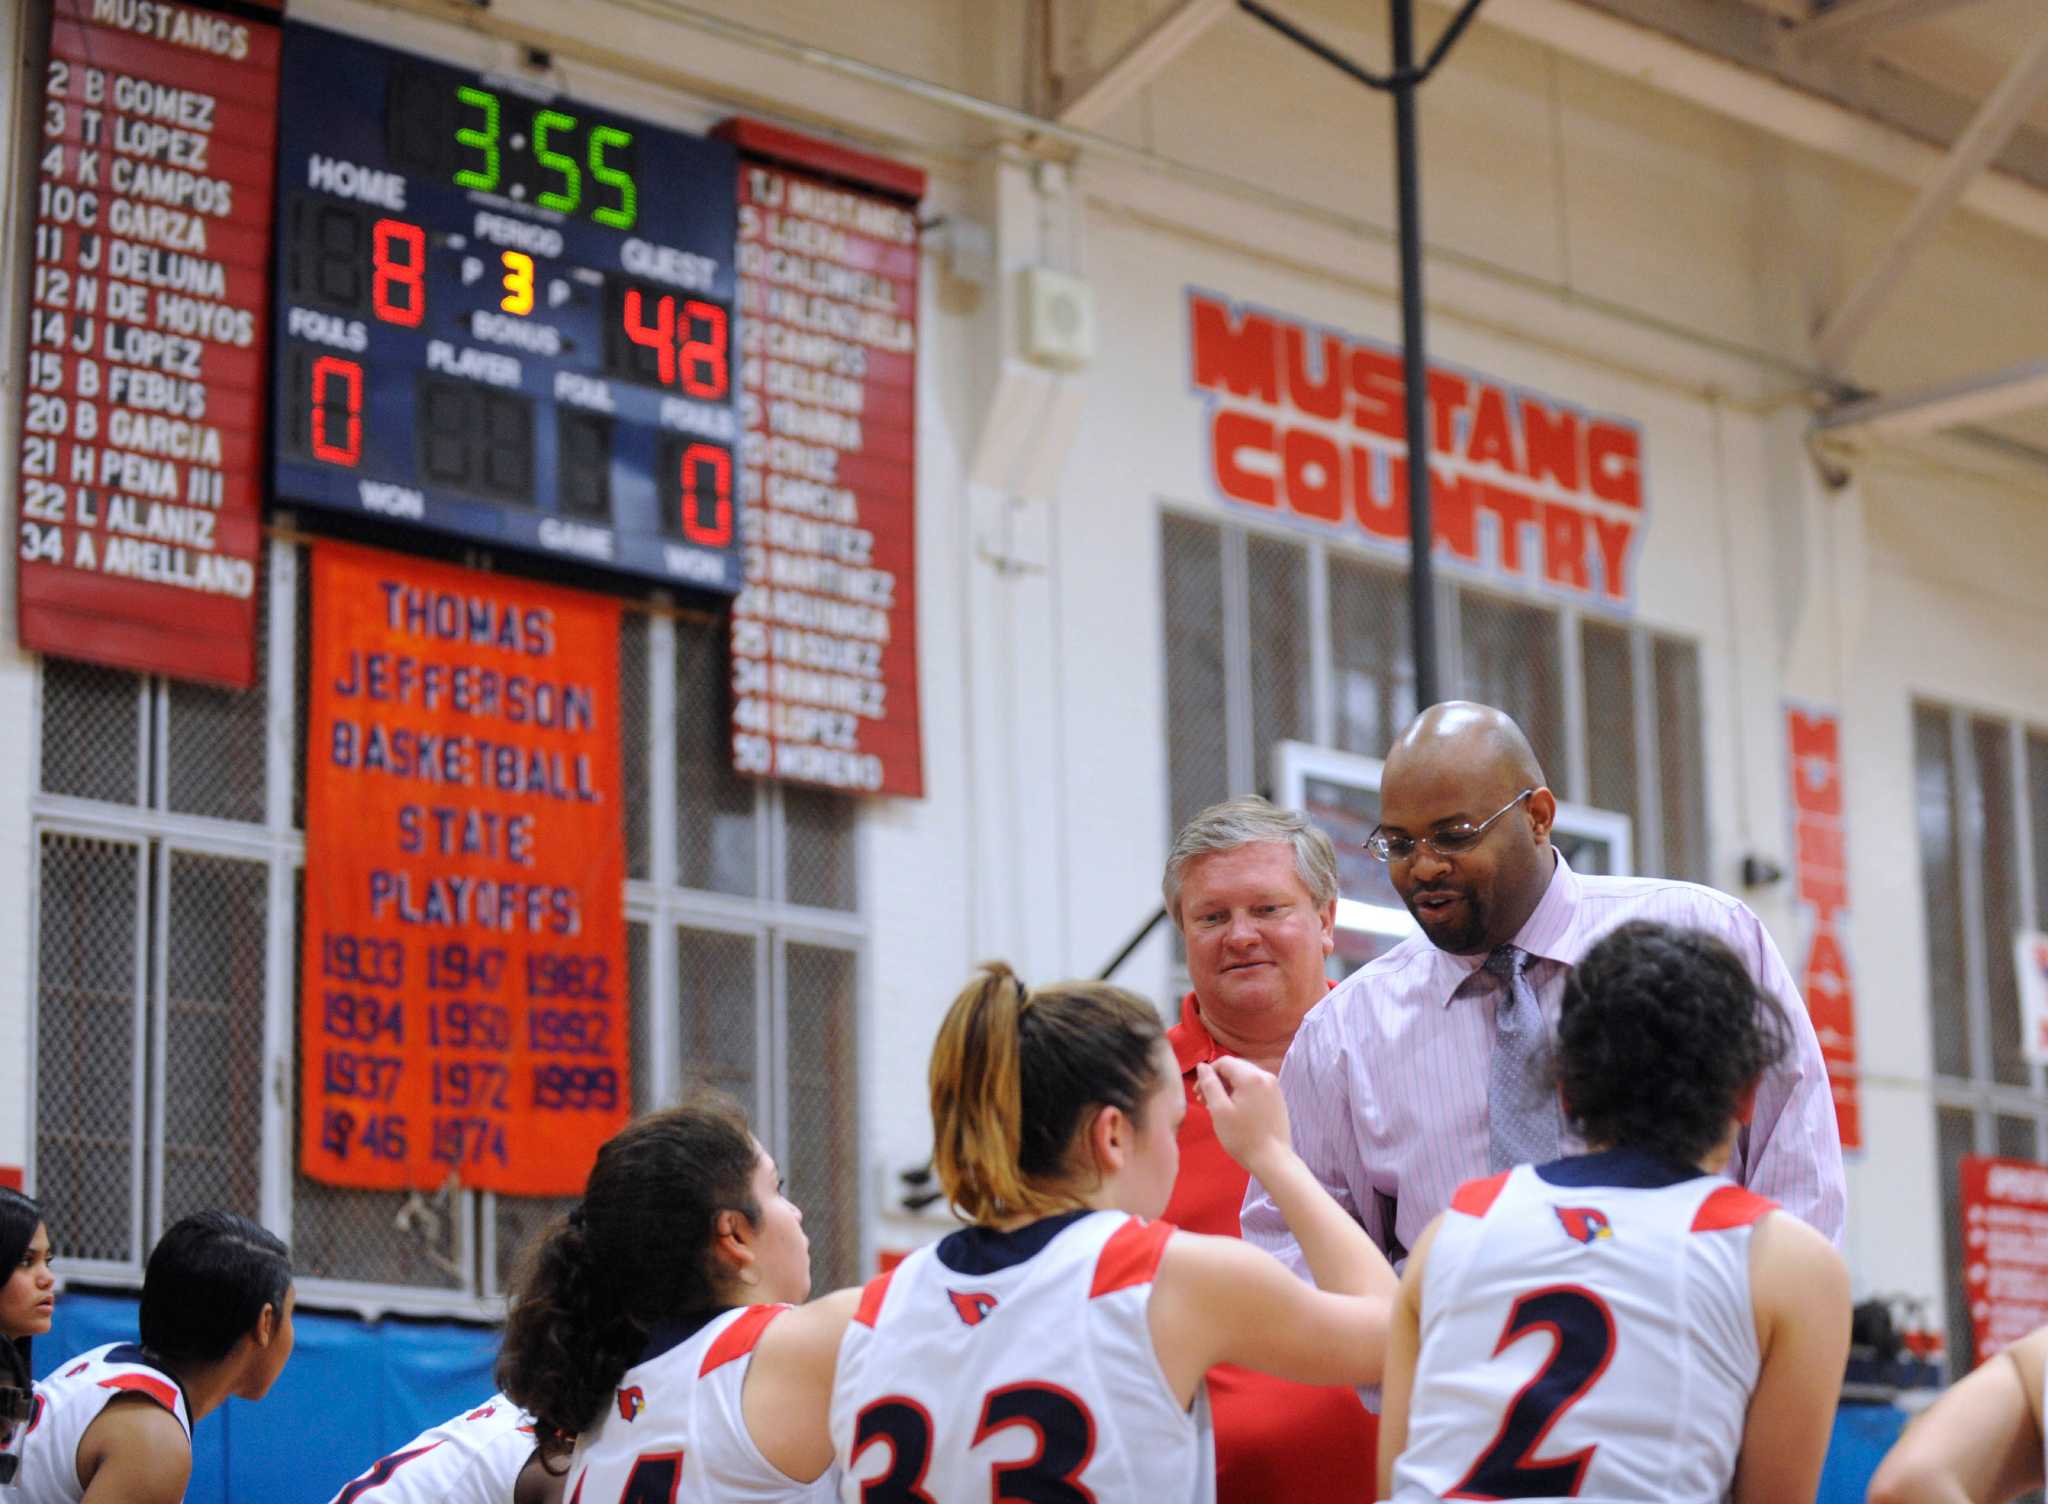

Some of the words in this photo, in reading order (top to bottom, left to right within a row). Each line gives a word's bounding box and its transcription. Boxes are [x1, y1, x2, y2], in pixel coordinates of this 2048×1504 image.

[93, 0, 249, 60] MUSTANGS
[47, 60, 70, 95] 2
[85, 68, 104, 103] B
[114, 75, 215, 132] GOMEZ
[45, 102, 65, 136] 3
[82, 109, 102, 145] T
[114, 117, 208, 170] LOPEZ
[453, 85, 639, 231] 3:55
[41, 145, 64, 178] 4
[79, 151, 98, 185] K
[110, 157, 231, 217] CAMPOS
[307, 153, 408, 211] HOME
[40, 183, 74, 223] 10
[77, 192, 98, 228] C
[109, 198, 207, 252] GARZA
[474, 209, 564, 259] PERIOD
[36, 223, 63, 262] 11
[79, 235, 101, 269] J
[109, 240, 226, 298] DELUNA
[372, 218, 427, 329] 8
[500, 250, 535, 316] 3
[619, 236, 719, 291] GUEST
[34, 265, 70, 306] 12
[76, 277, 98, 312] N
[106, 280, 147, 323] DE
[156, 292, 254, 347] HOYOS
[288, 307, 368, 353] FOULS
[471, 310, 561, 355] BONUS
[32, 309, 65, 348] 14
[72, 317, 94, 352] J
[104, 322, 204, 378] LOPEZ
[427, 340, 522, 388] PLAYER
[624, 287, 729, 401] 48
[29, 351, 63, 391] 15
[76, 360, 99, 398] B
[108, 367, 207, 419] FEBUS
[311, 355, 364, 468] 0
[554, 371, 616, 412] FOUL
[1188, 292, 1645, 509] MUSTANG
[26, 393, 67, 434] 20
[75, 401, 98, 439] B
[108, 409, 222, 466] GARCIA
[22, 438, 57, 476] 21
[71, 444, 95, 483] H
[101, 449, 178, 499] PENA
[187, 466, 224, 509] III
[358, 479, 425, 519] WON
[680, 442, 733, 549] 0
[1211, 408, 1634, 601] COUNTRY
[20, 521, 64, 564] 34
[75, 531, 97, 570] A
[23, 480, 67, 522] 22
[76, 487, 97, 527] L
[106, 494, 217, 550] ALANIZ
[538, 517, 614, 562] GAME
[661, 546, 726, 584] WON
[380, 578, 556, 657] THOMAS
[334, 651, 597, 733] JEFFERSON
[332, 720, 604, 804] BASKETBALL
[400, 804, 536, 869] STATE
[370, 870, 582, 937] PLAYOFFS
[322, 931, 404, 989] 1933
[322, 990, 403, 1045] 1934
[323, 1050, 404, 1103] 1937
[431, 1059, 510, 1111] 1972
[532, 1063, 620, 1113] 1999
[430, 1115, 508, 1168] 1974
[1440, 1283, 1617, 1497] 2
